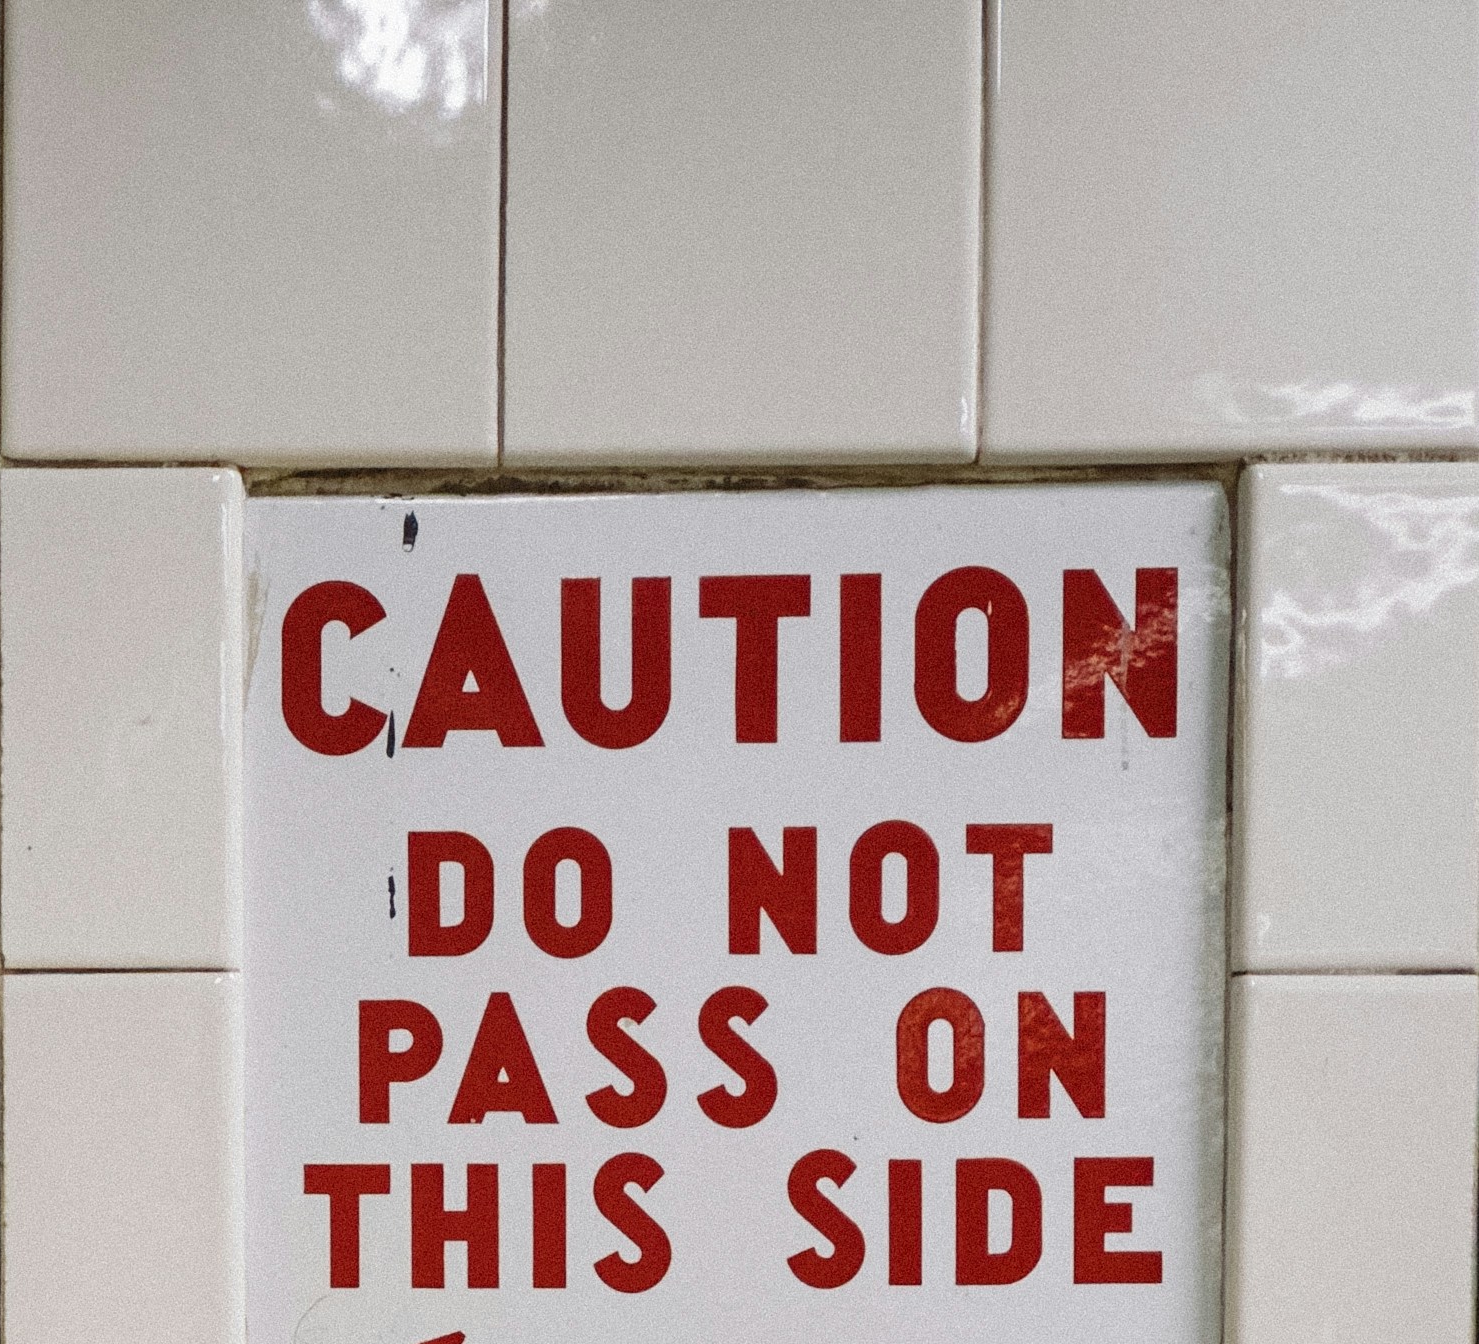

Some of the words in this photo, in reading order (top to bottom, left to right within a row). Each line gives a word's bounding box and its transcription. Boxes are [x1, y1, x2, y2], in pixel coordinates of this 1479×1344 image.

[283, 567, 1177, 755] CAUTION
[409, 828, 613, 958] DO
[729, 821, 1053, 957] NOT
[360, 987, 777, 1128] PASS
[897, 987, 1106, 1123] ON
[305, 1153, 672, 1293] THIS
[788, 1150, 1163, 1289] SIDE
